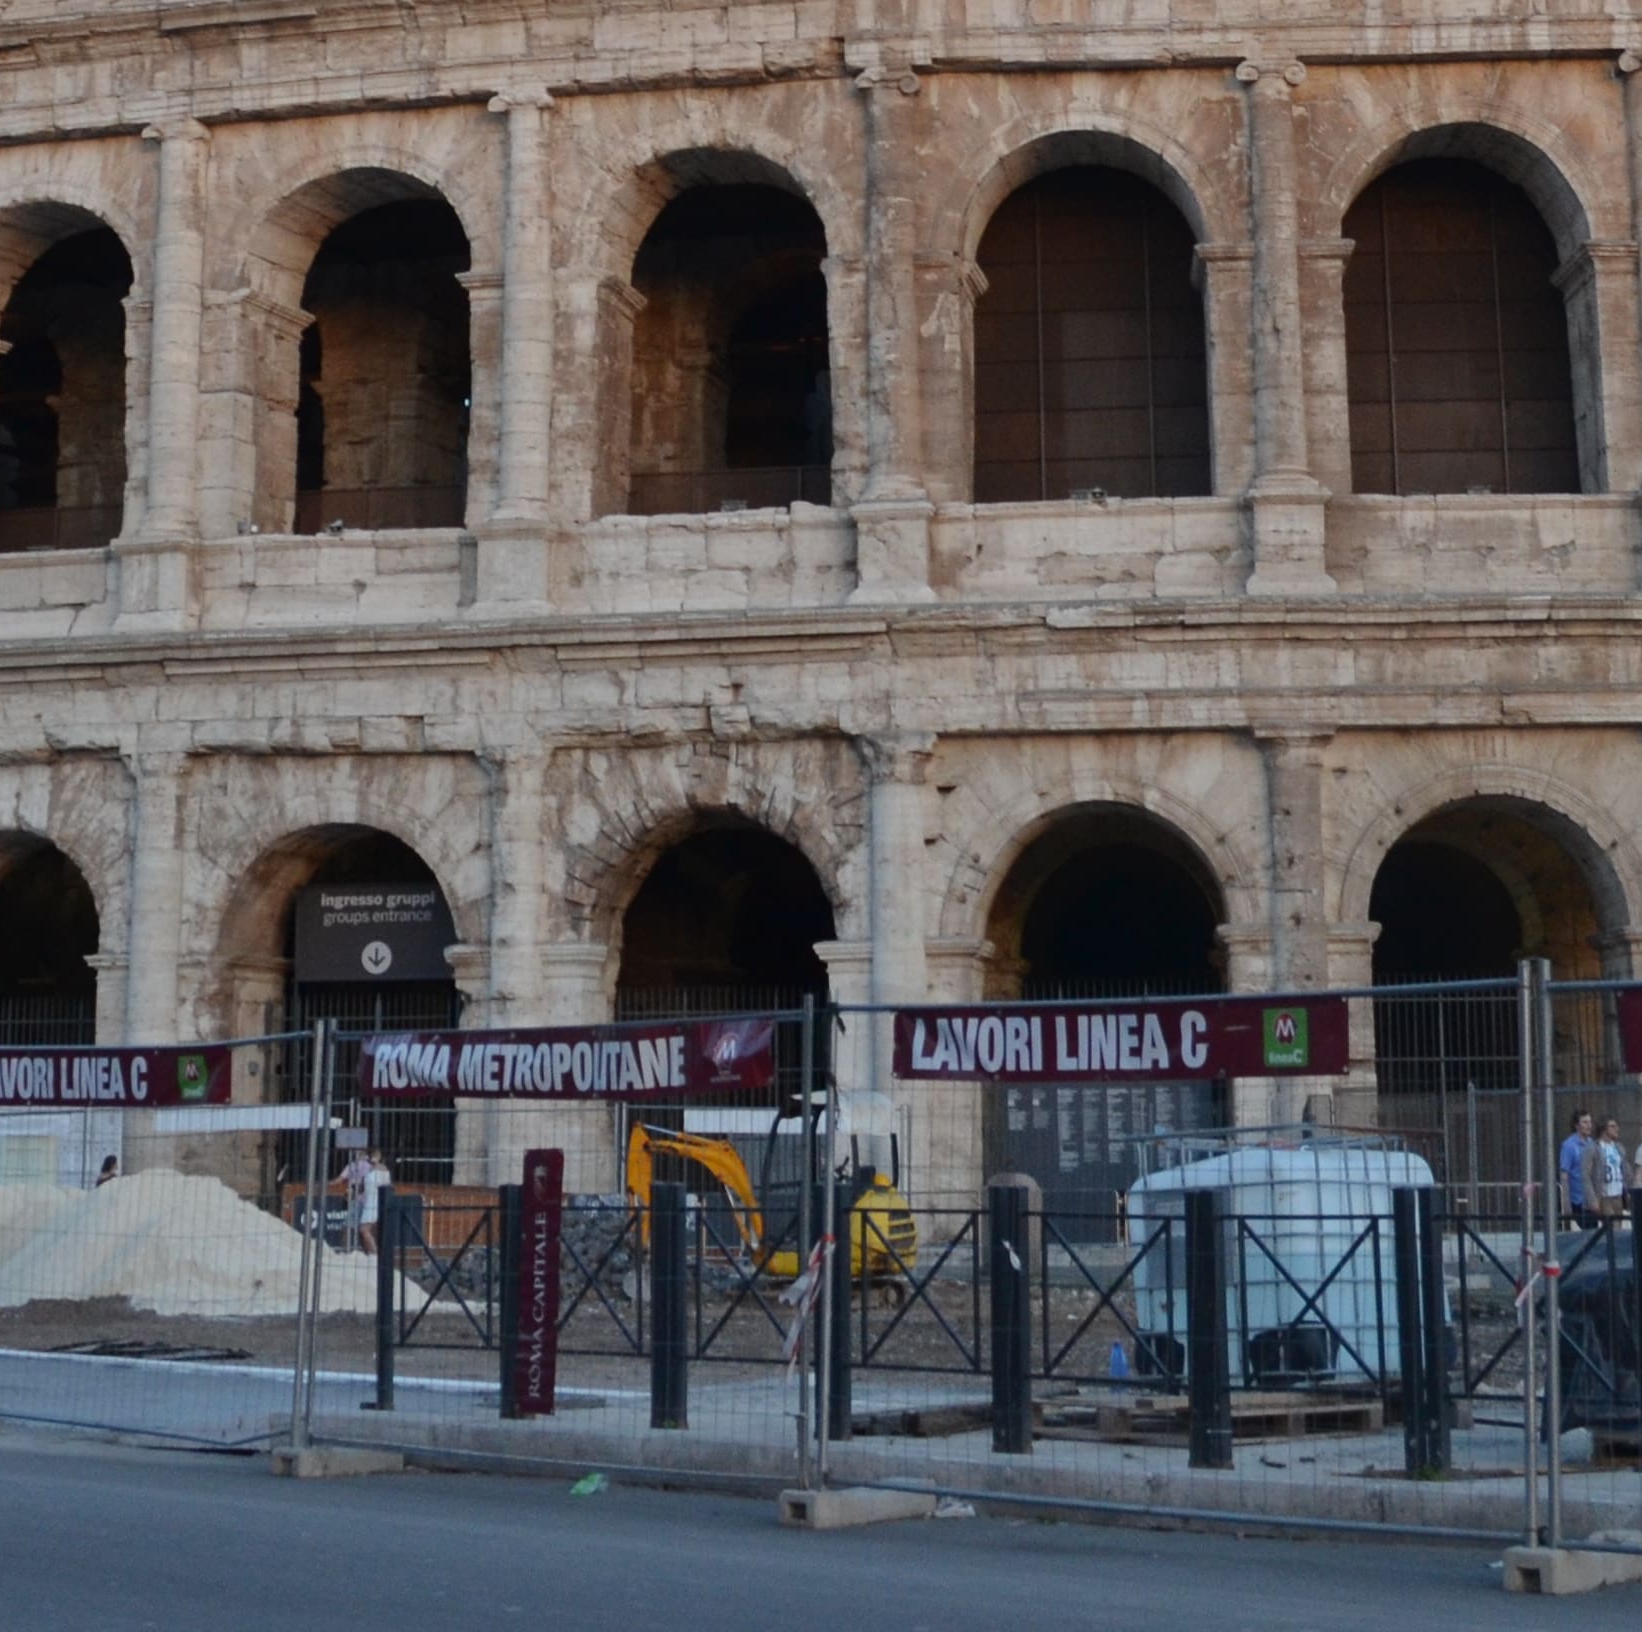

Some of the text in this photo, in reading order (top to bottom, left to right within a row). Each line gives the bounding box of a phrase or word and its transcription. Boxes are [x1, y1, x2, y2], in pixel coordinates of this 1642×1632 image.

[320, 890, 436, 909] ingresso gruppi
[322, 909, 433, 928] groups entrance
[372, 1036, 686, 1092] ROMA METROPOLITANE
[911, 1009, 1209, 1072] LAVORI LINEA C
[60, 1056, 126, 1100] LINEA
[130, 1056, 148, 1100] C
[528, 1210, 547, 1399] ROMA CAPITALE
